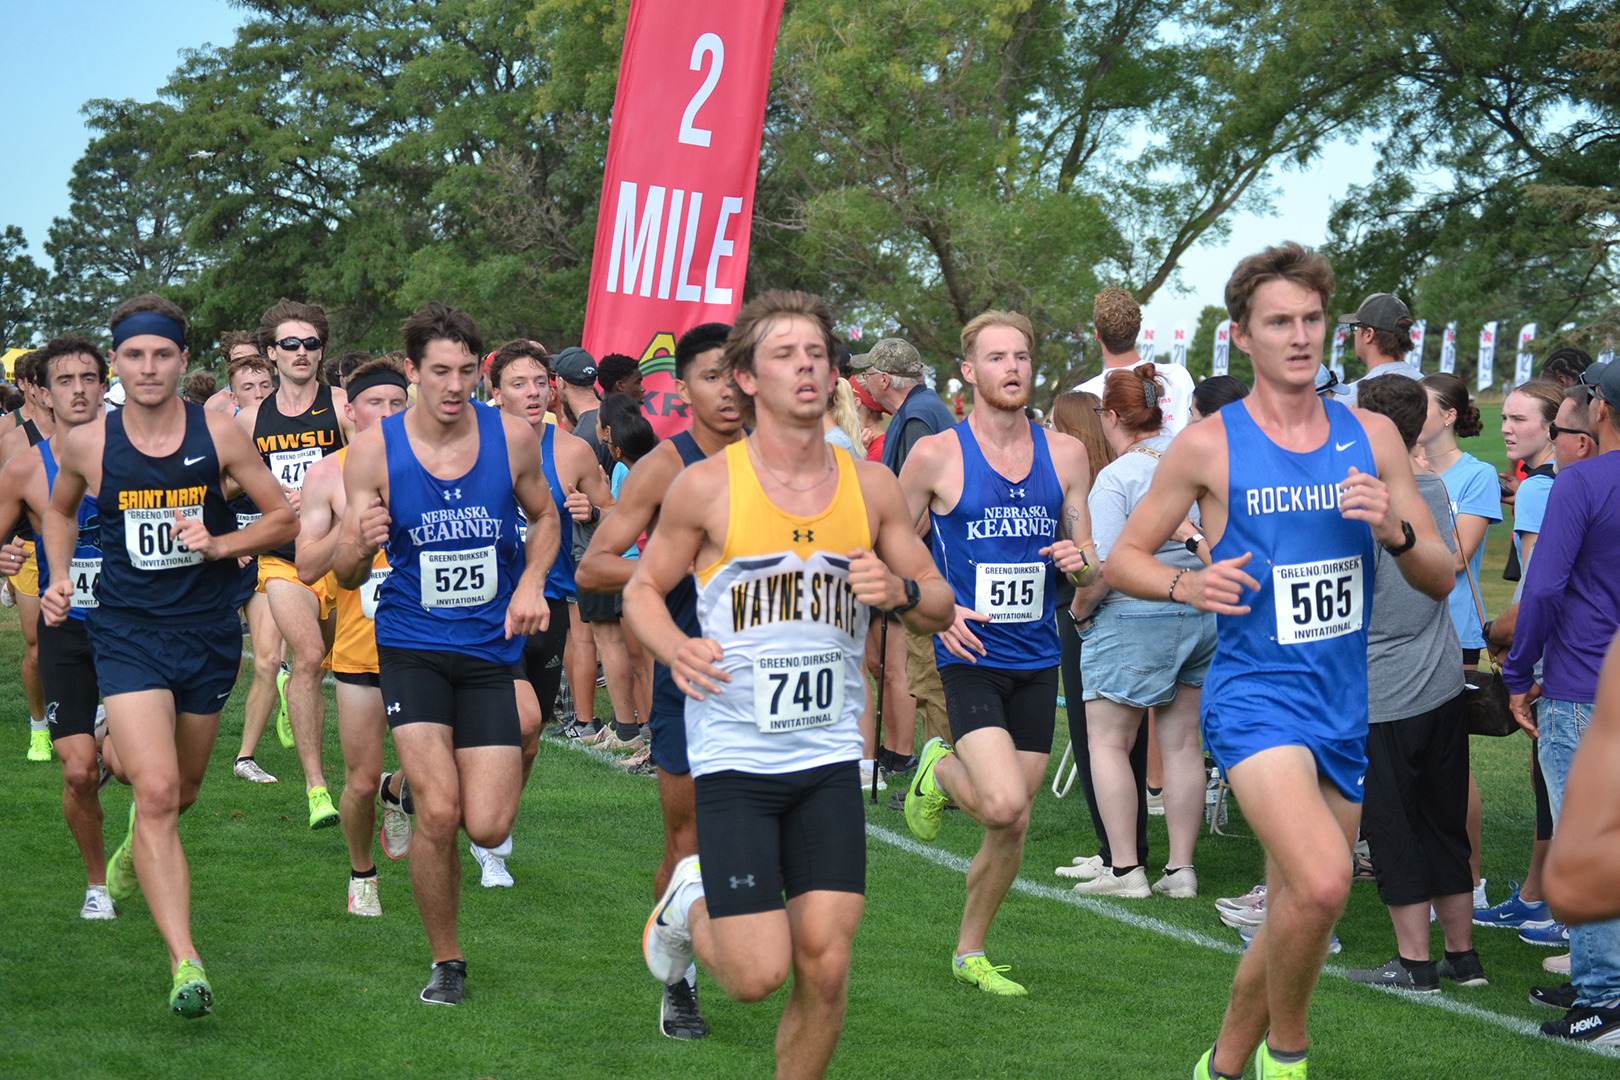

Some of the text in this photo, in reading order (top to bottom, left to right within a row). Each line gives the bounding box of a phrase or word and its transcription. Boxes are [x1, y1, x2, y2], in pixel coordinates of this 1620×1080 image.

[678, 32, 724, 147] 2
[606, 180, 743, 305] MILE
[1218, 329, 1228, 340] N
[1215, 344, 1228, 369] 20
[256, 429, 335, 453] MWSU
[118, 490, 164, 510] SAINT
[165, 485, 207, 508] MARY
[421, 506, 489, 525] NEBRASKA
[984, 505, 1048, 519] NEBRASKA
[408, 519, 503, 545] KEARNEY
[966, 518, 1058, 541] KEARNEY
[140, 556, 193, 568] INVITATIONAL
[1280, 559, 1360, 579] GREENO/DIRKSEN
[435, 564, 485, 593] 525
[436, 595, 486, 606] INVITATIONAL
[731, 569, 804, 633] WAYNE
[990, 580, 1035, 607] 515
[1291, 575, 1353, 625] 565
[811, 572, 858, 639] STATE
[1294, 622, 1352, 640] INVITATIONAL
[759, 651, 842, 669] GREENO/DIRKSEN
[768, 668, 833, 715] 740
[770, 712, 832, 730] INVITATIONAL
[1570, 1015, 1603, 1034] HOKA
